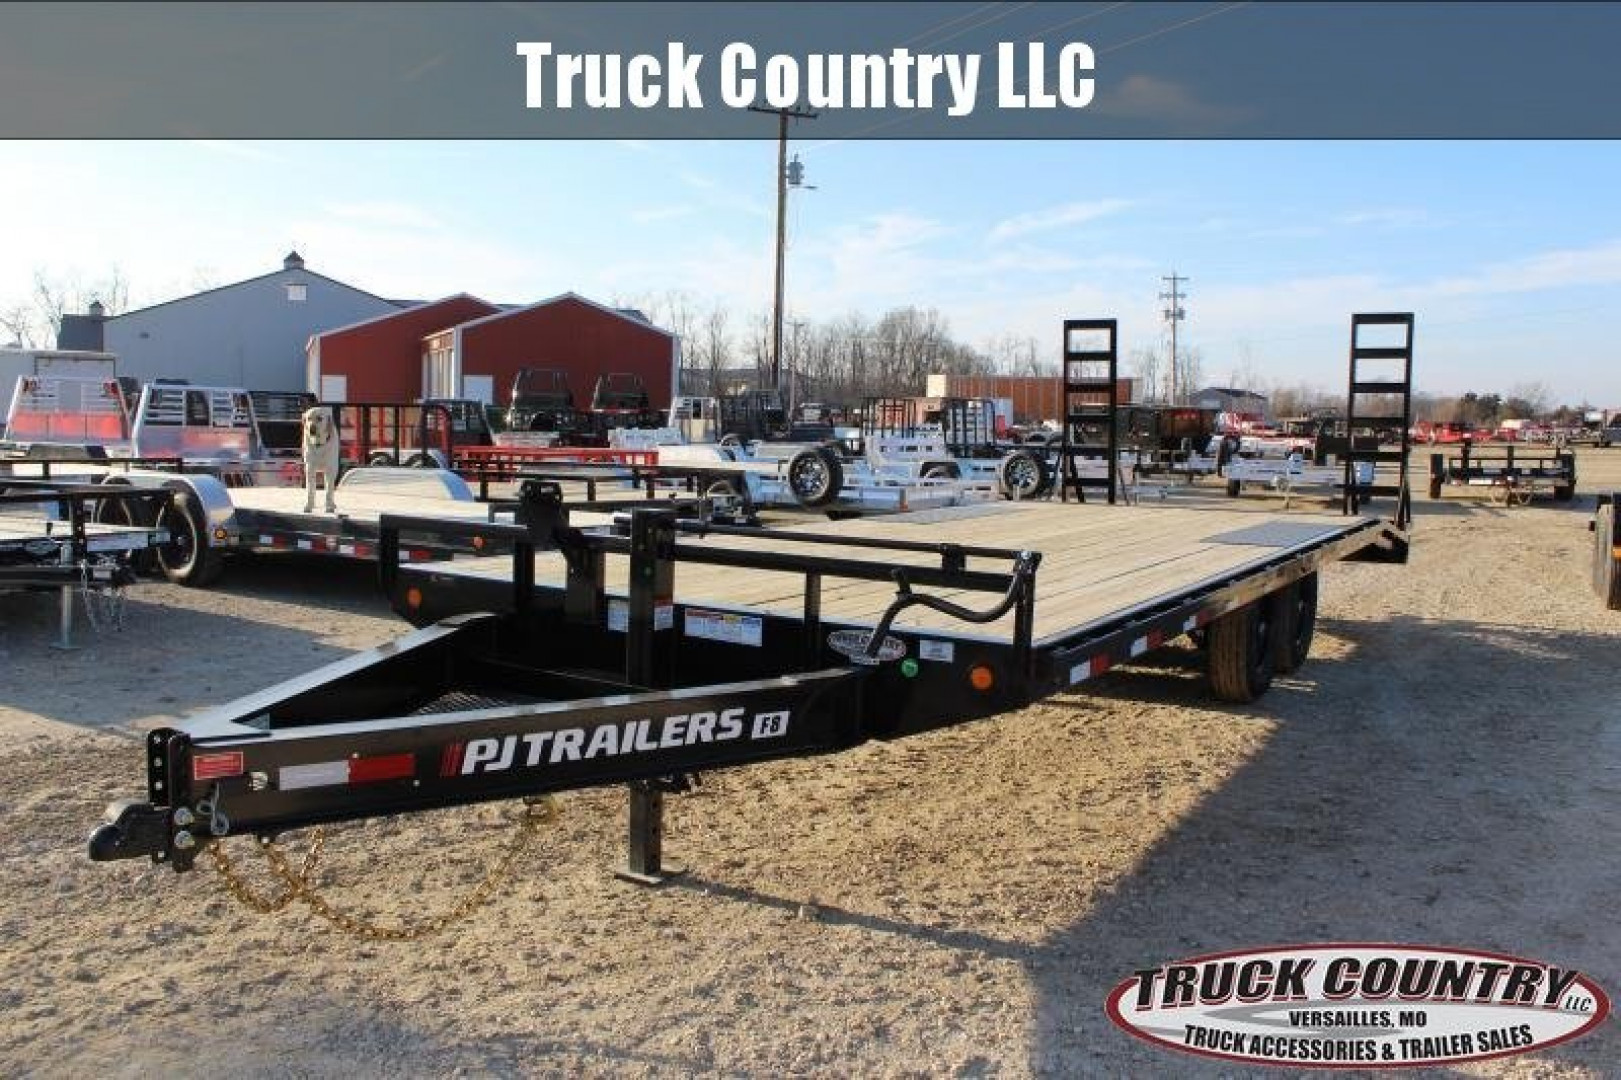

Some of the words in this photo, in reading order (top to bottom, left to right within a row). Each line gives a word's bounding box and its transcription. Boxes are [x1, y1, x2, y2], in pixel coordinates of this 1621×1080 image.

[461, 738, 517, 775] PJ
[523, 707, 746, 768] TRAILERS
[760, 714, 782, 735] F8
